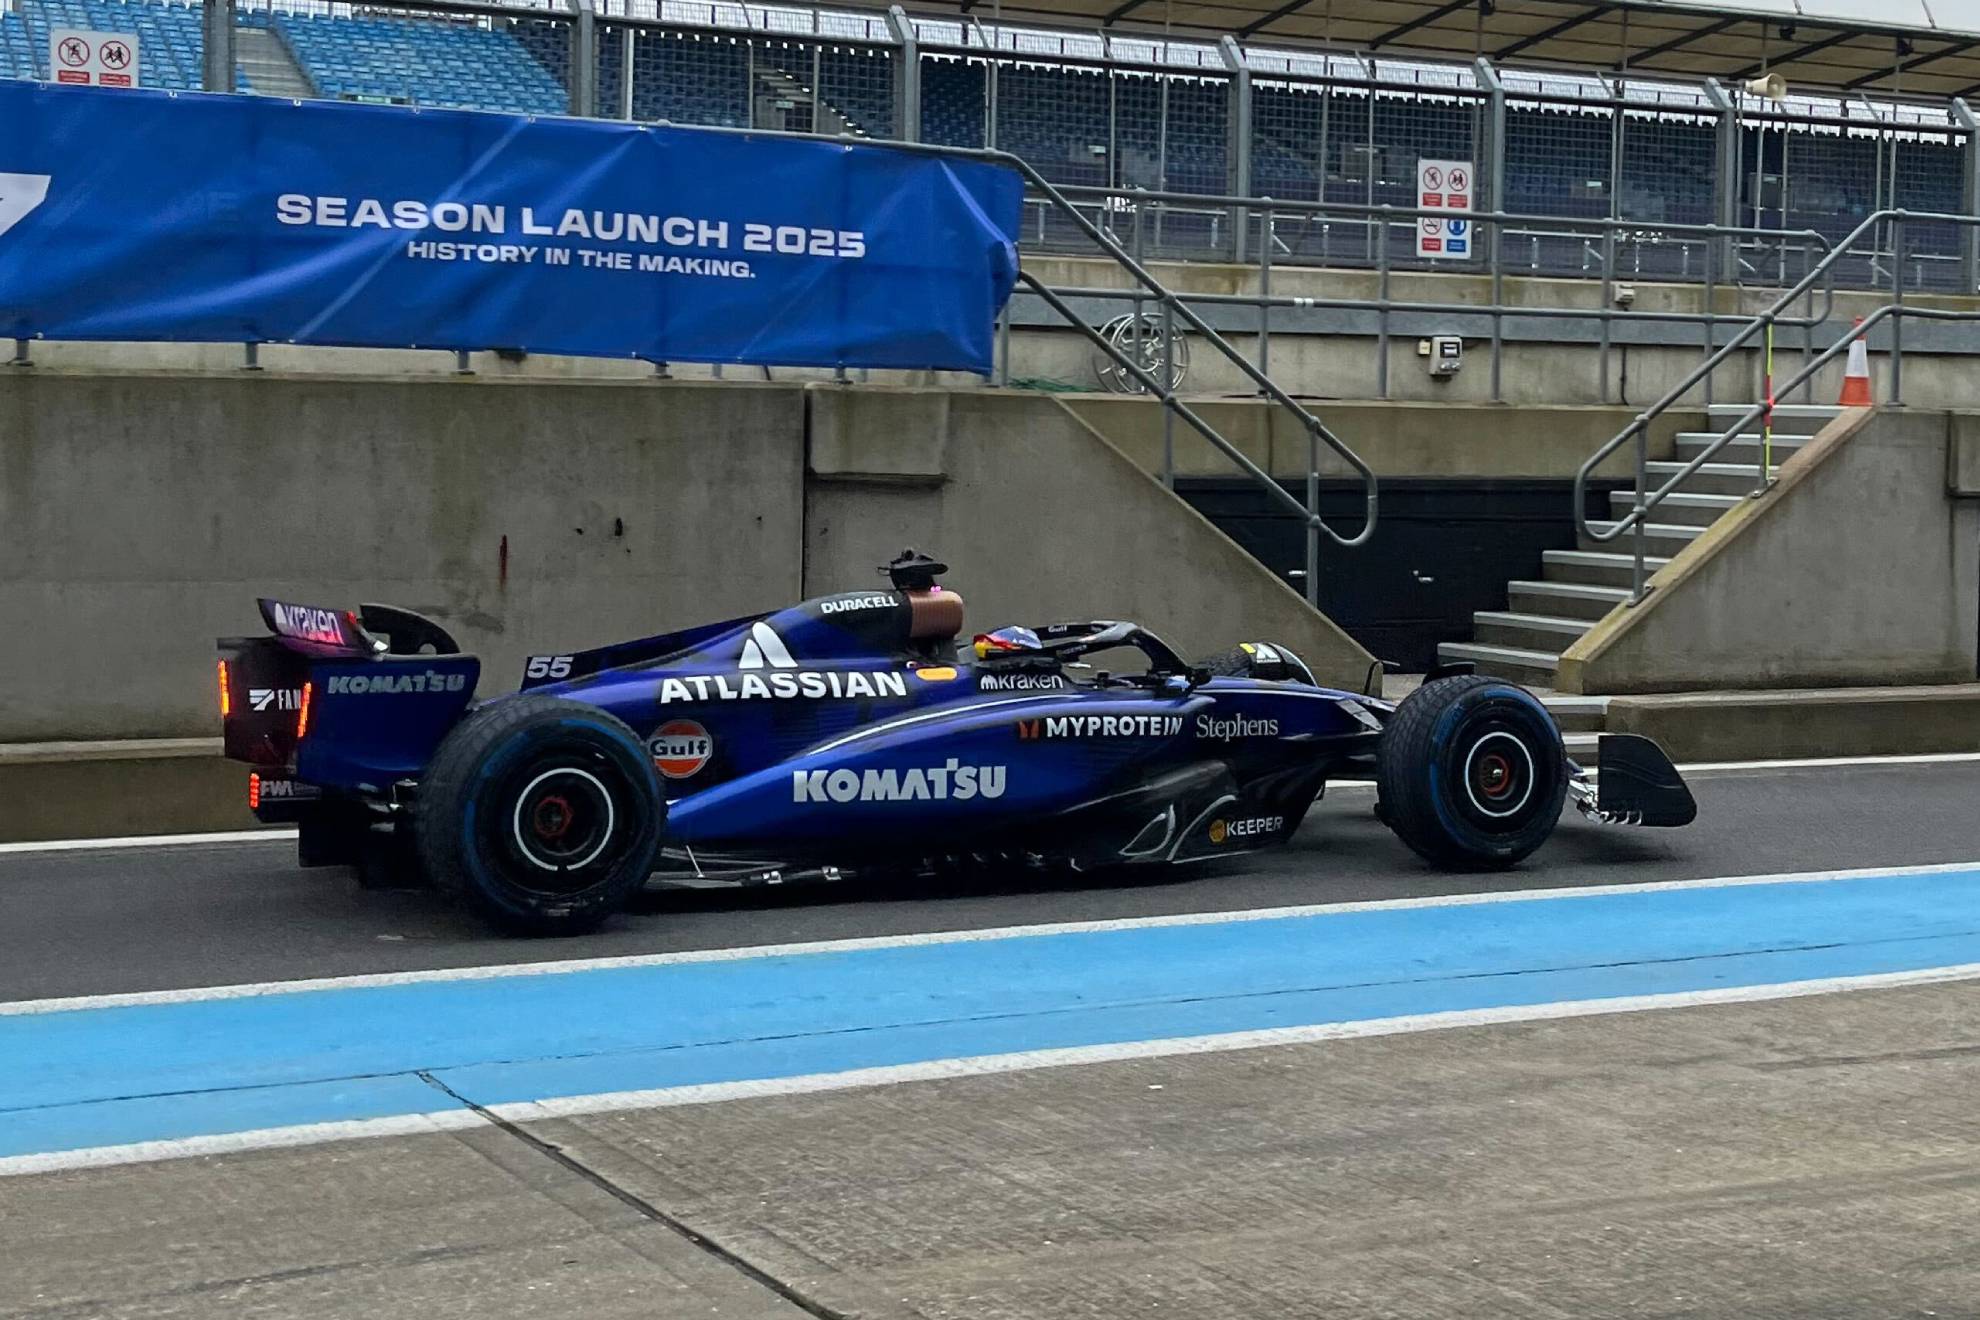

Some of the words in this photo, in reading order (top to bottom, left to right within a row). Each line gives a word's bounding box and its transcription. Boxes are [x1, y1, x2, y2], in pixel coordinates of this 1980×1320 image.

[277, 194, 505, 234] SEASON
[521, 206, 728, 249] LAUNCH
[743, 223, 866, 259] 2025
[408, 241, 538, 264] HISTORY
[545, 248, 570, 266] IN
[578, 250, 633, 271] THE
[639, 255, 756, 279] MAKING.
[821, 596, 898, 614] DURACELL
[527, 657, 573, 679] 55
[327, 670, 465, 695] KOMATSU
[660, 671, 907, 704] ATLASSIAN
[1046, 716, 1183, 738] MYPROTEIN
[1196, 713, 1279, 742] Stephens
[650, 737, 708, 757] Gulf
[793, 758, 1006, 803] KOMATSU
[1226, 816, 1284, 838] KEEPER
